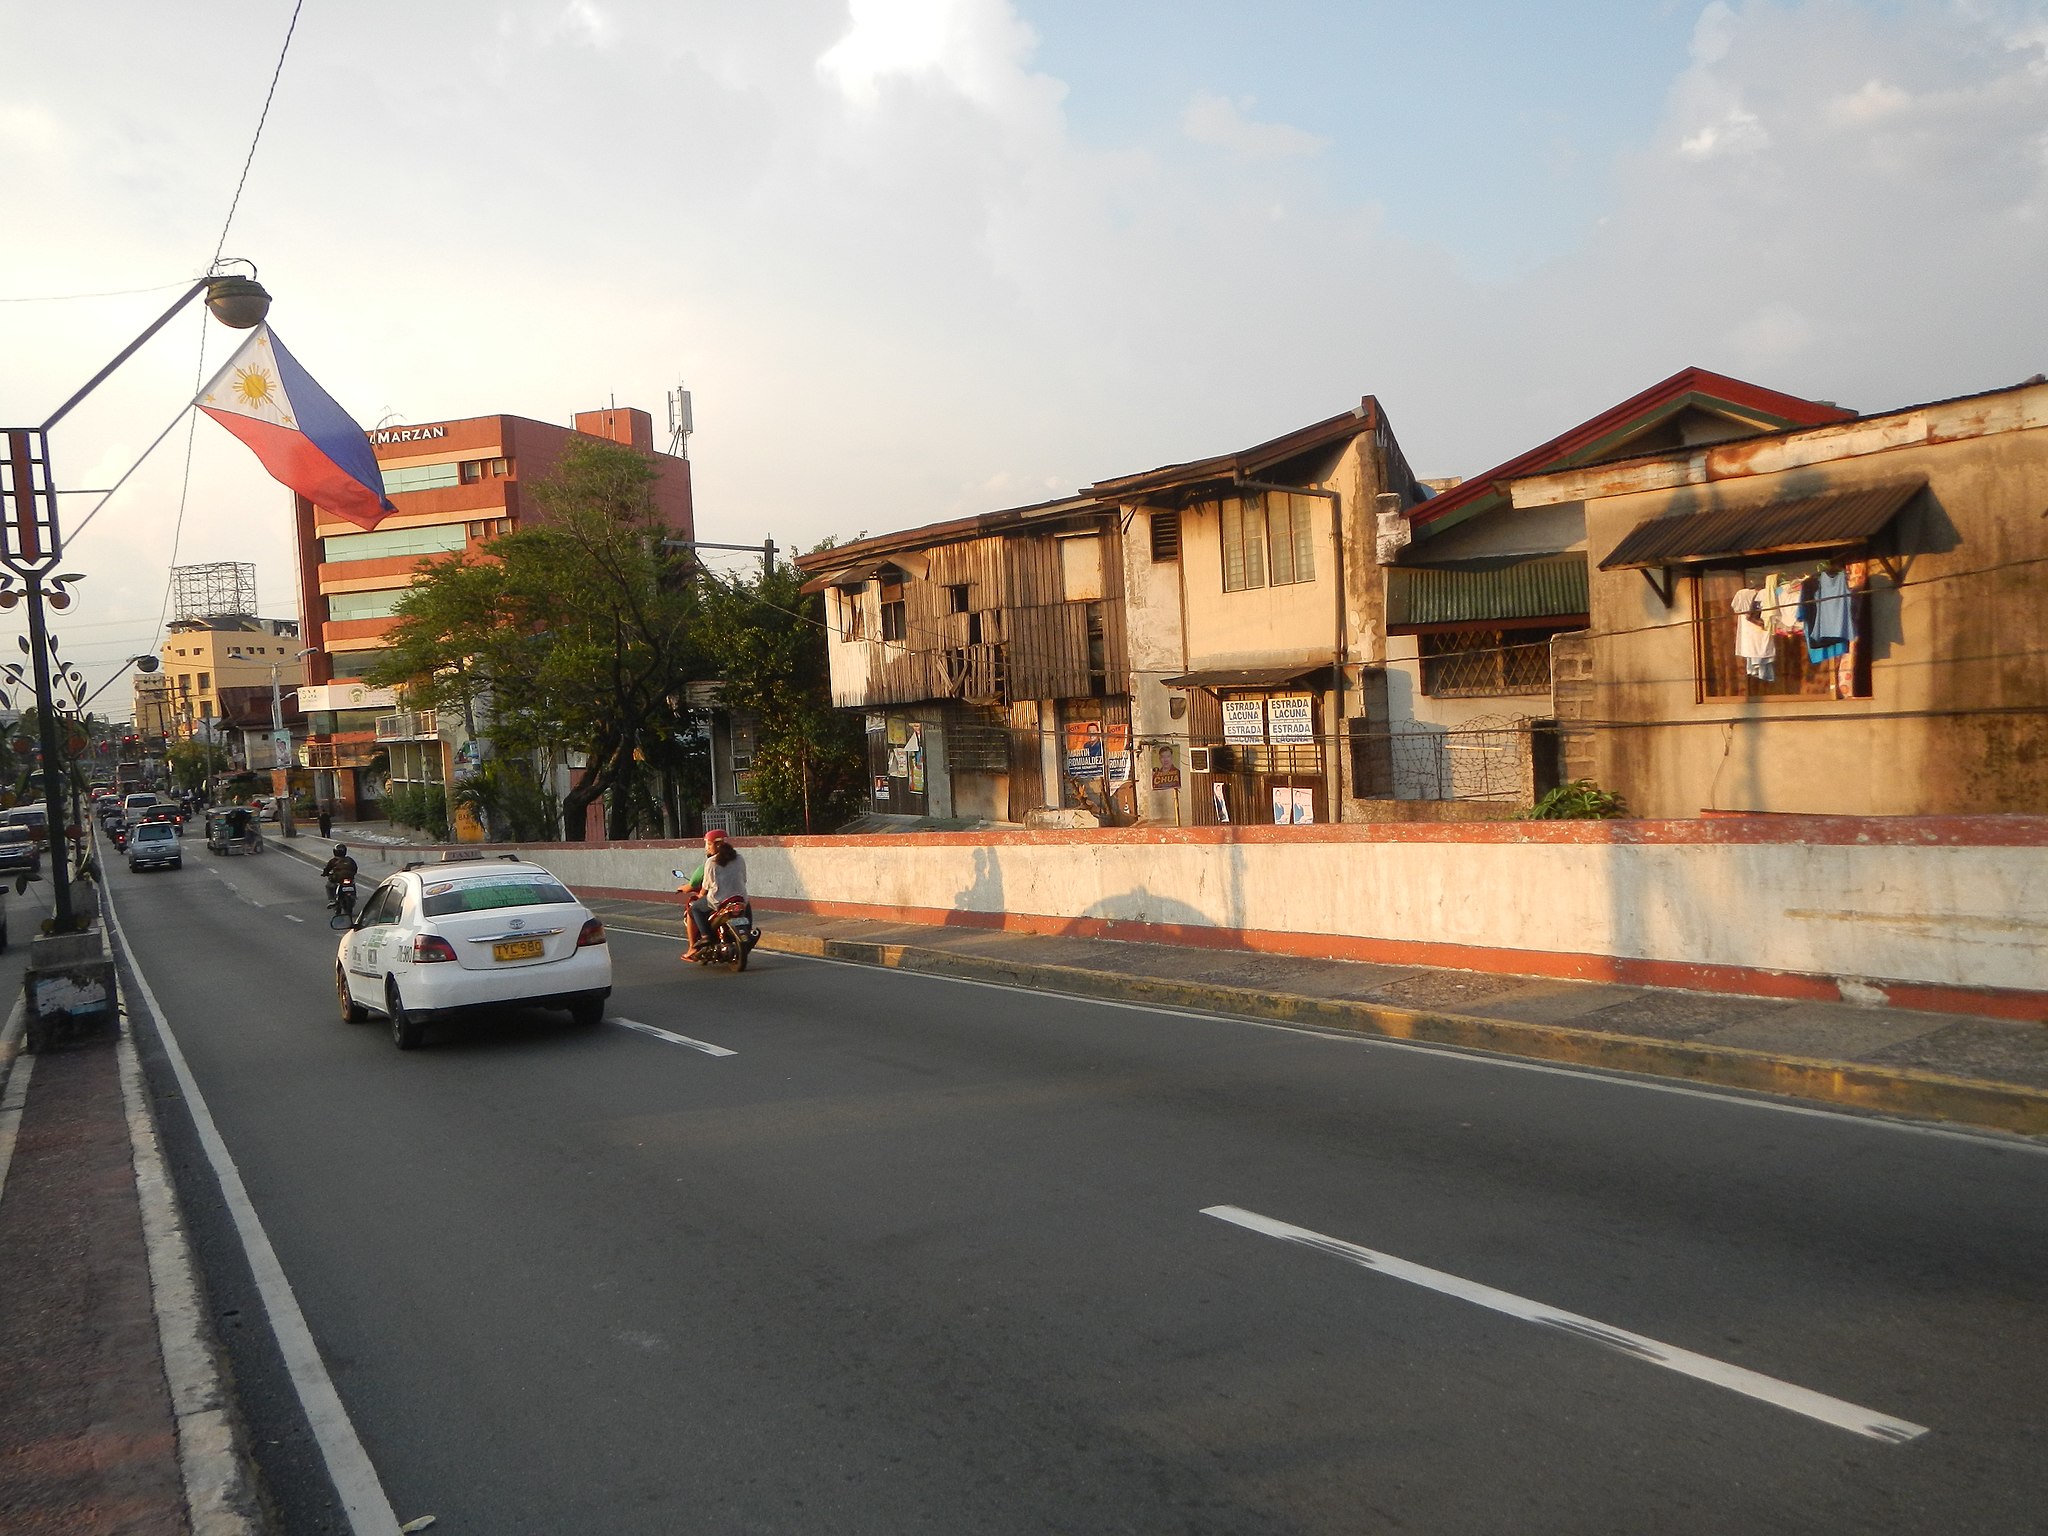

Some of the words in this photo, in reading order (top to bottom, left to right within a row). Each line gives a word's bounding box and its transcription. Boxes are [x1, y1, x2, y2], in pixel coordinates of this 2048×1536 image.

[377, 426, 445, 445] MARZAN
[1225, 701, 1261, 712] ESTRADA
[1271, 698, 1309, 709] ESTRADA
[1228, 711, 1259, 720] LACUNA
[1274, 708, 1308, 718] LACUNA
[1227, 725, 1261, 734] ESTRADA
[1272, 723, 1311, 733] ESTRADA
[1153, 775, 1179, 785] CHUA
[451, 850, 475, 858] TAXI
[520, 940, 542, 952] 980
